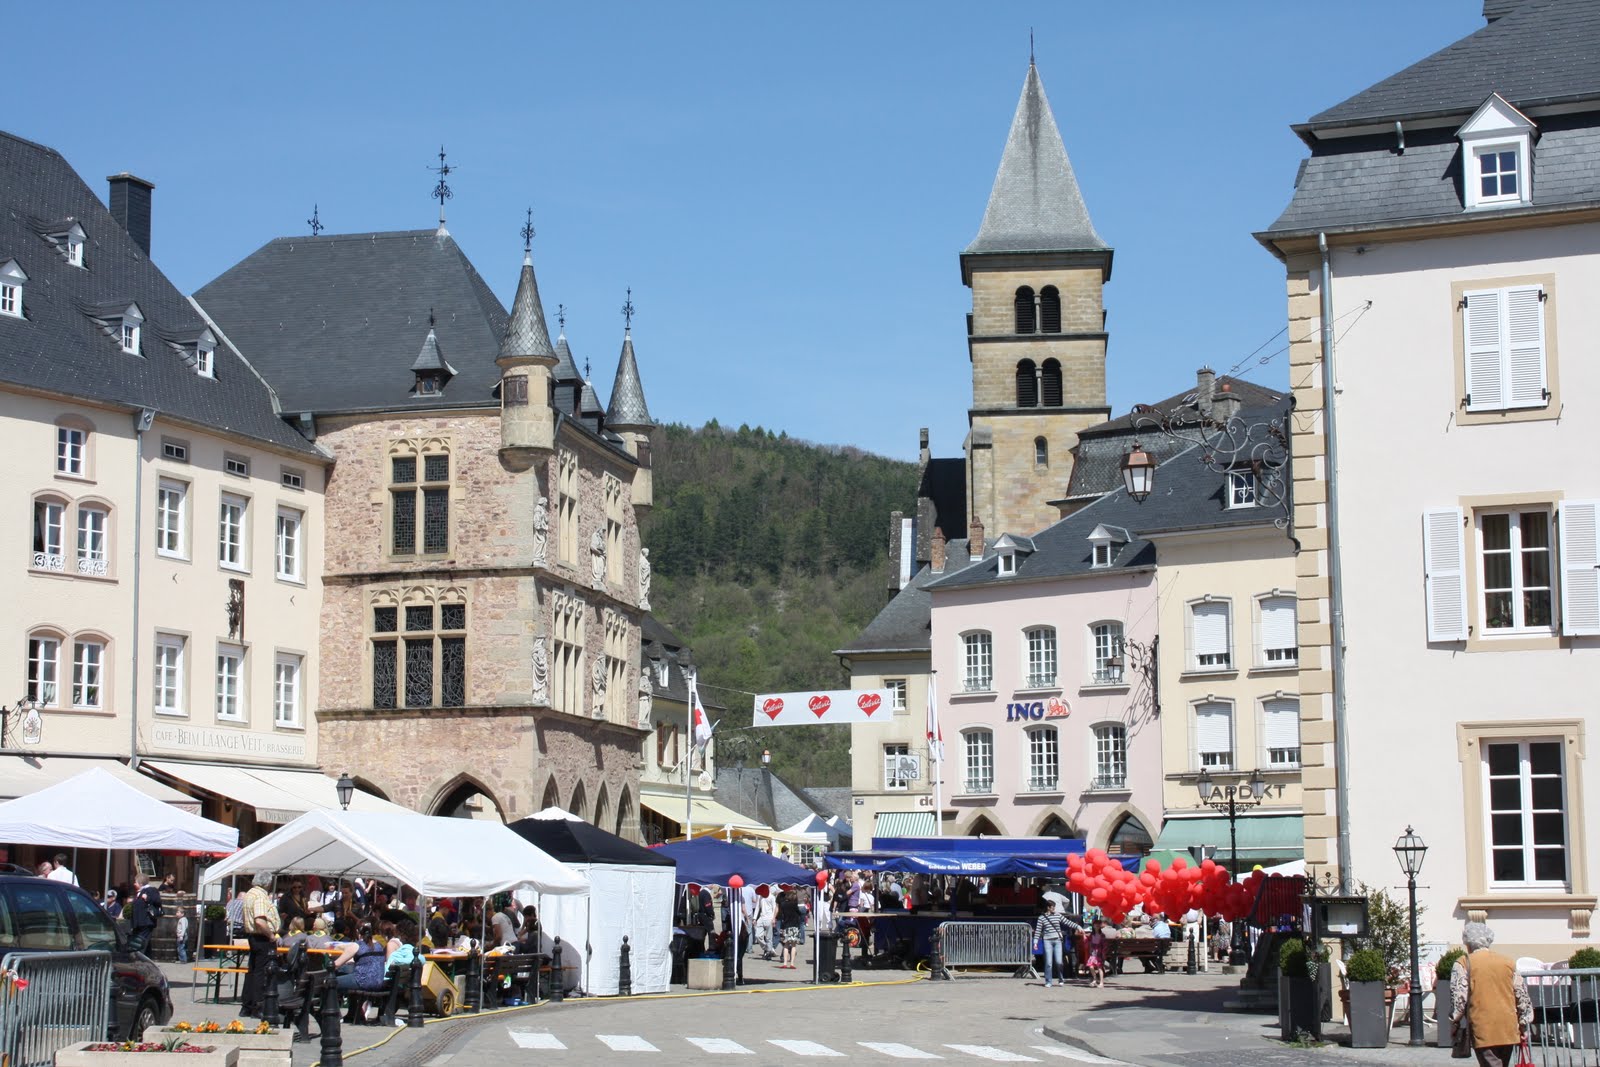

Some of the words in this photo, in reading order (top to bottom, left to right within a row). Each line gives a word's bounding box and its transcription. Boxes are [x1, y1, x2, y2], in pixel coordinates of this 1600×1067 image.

[1006, 701, 1044, 722] ING
[178, 728, 200, 746] BEIM
[203, 731, 239, 749] LAANGE
[241, 734, 262, 752] VEIT
[266, 743, 304, 756] BRASSERIE
[897, 770, 918, 779] ING
[1210, 784, 1286, 801] APDKT
[961, 862, 986, 870] WEBER
